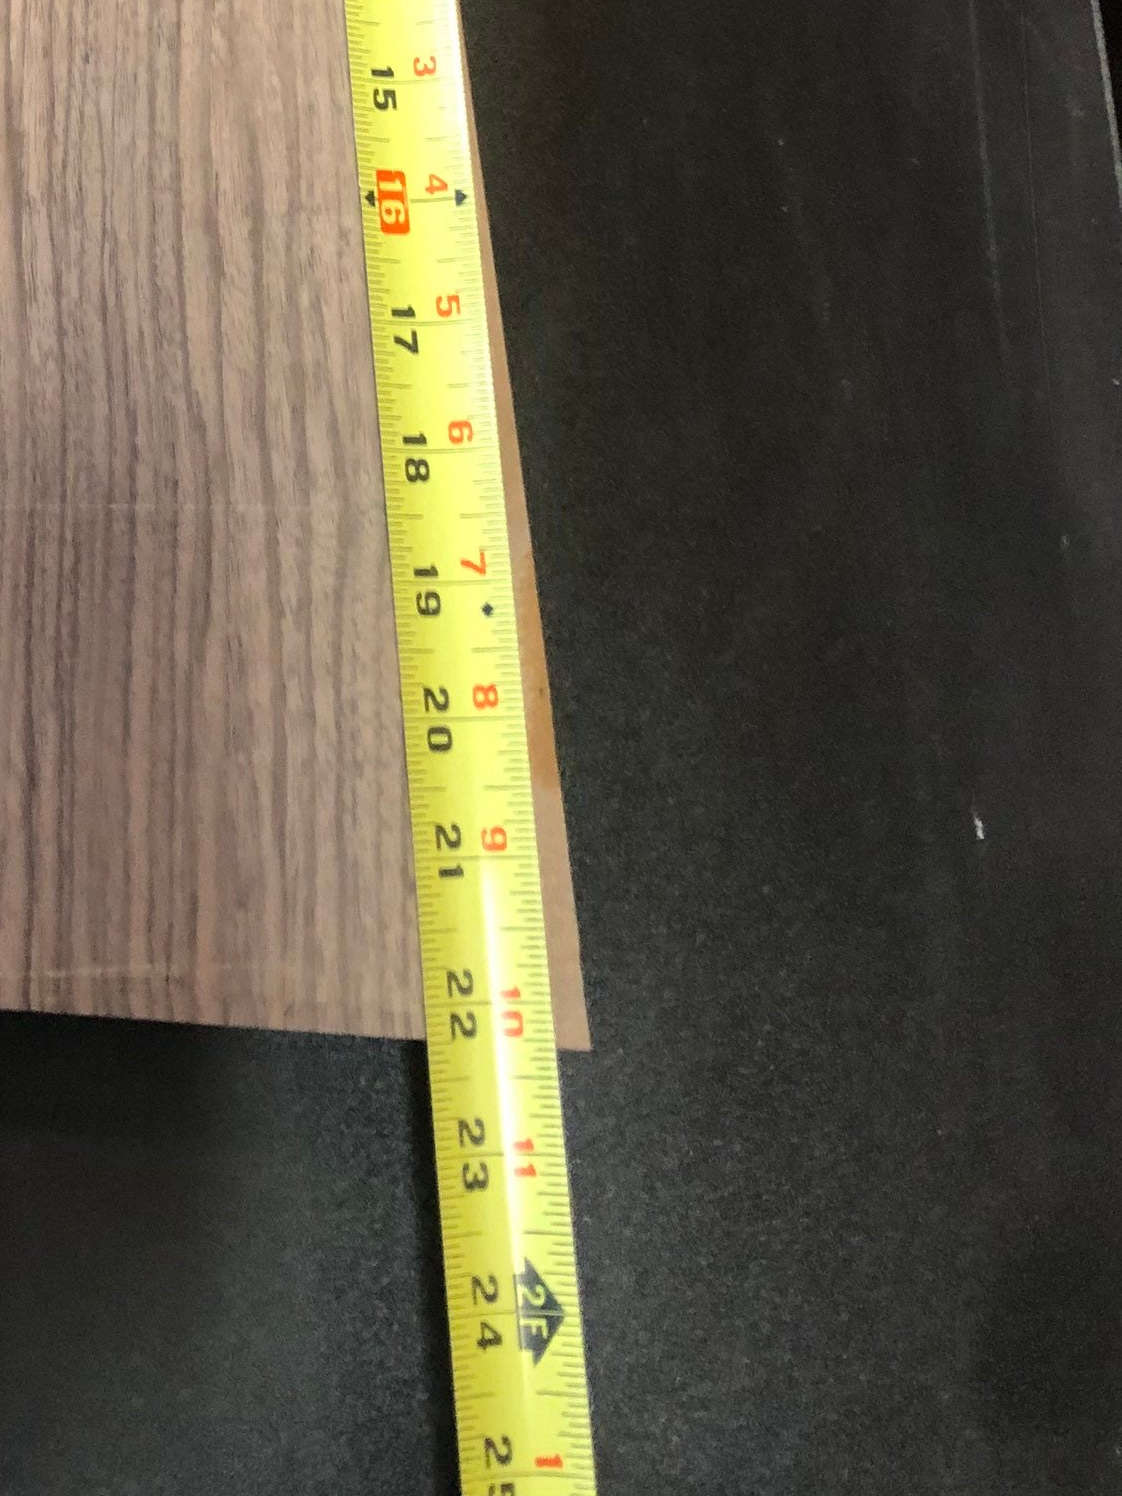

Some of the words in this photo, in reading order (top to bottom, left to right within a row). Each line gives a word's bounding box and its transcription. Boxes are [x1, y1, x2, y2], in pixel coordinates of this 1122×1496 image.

[371, 66, 398, 111] 15
[413, 56, 436, 77] 3
[381, 173, 408, 227] 16
[425, 174, 448, 195] 4
[435, 294, 461, 318] 5
[391, 305, 419, 355] 17
[448, 420, 473, 444] 6
[402, 432, 430, 483] 18
[460, 550, 486, 576] 7
[413, 564, 441, 617] 19
[423, 686, 453, 753] 20
[472, 684, 499, 710] 8
[435, 824, 465, 878] 21
[480, 826, 507, 851] 9
[447, 969, 478, 1041] 22
[500, 986, 524, 1038] 10
[458, 1118, 489, 1193] 23
[513, 1137, 537, 1178] 11
[471, 1274, 503, 1352] 24
[534, 1454, 563, 1468] 1
